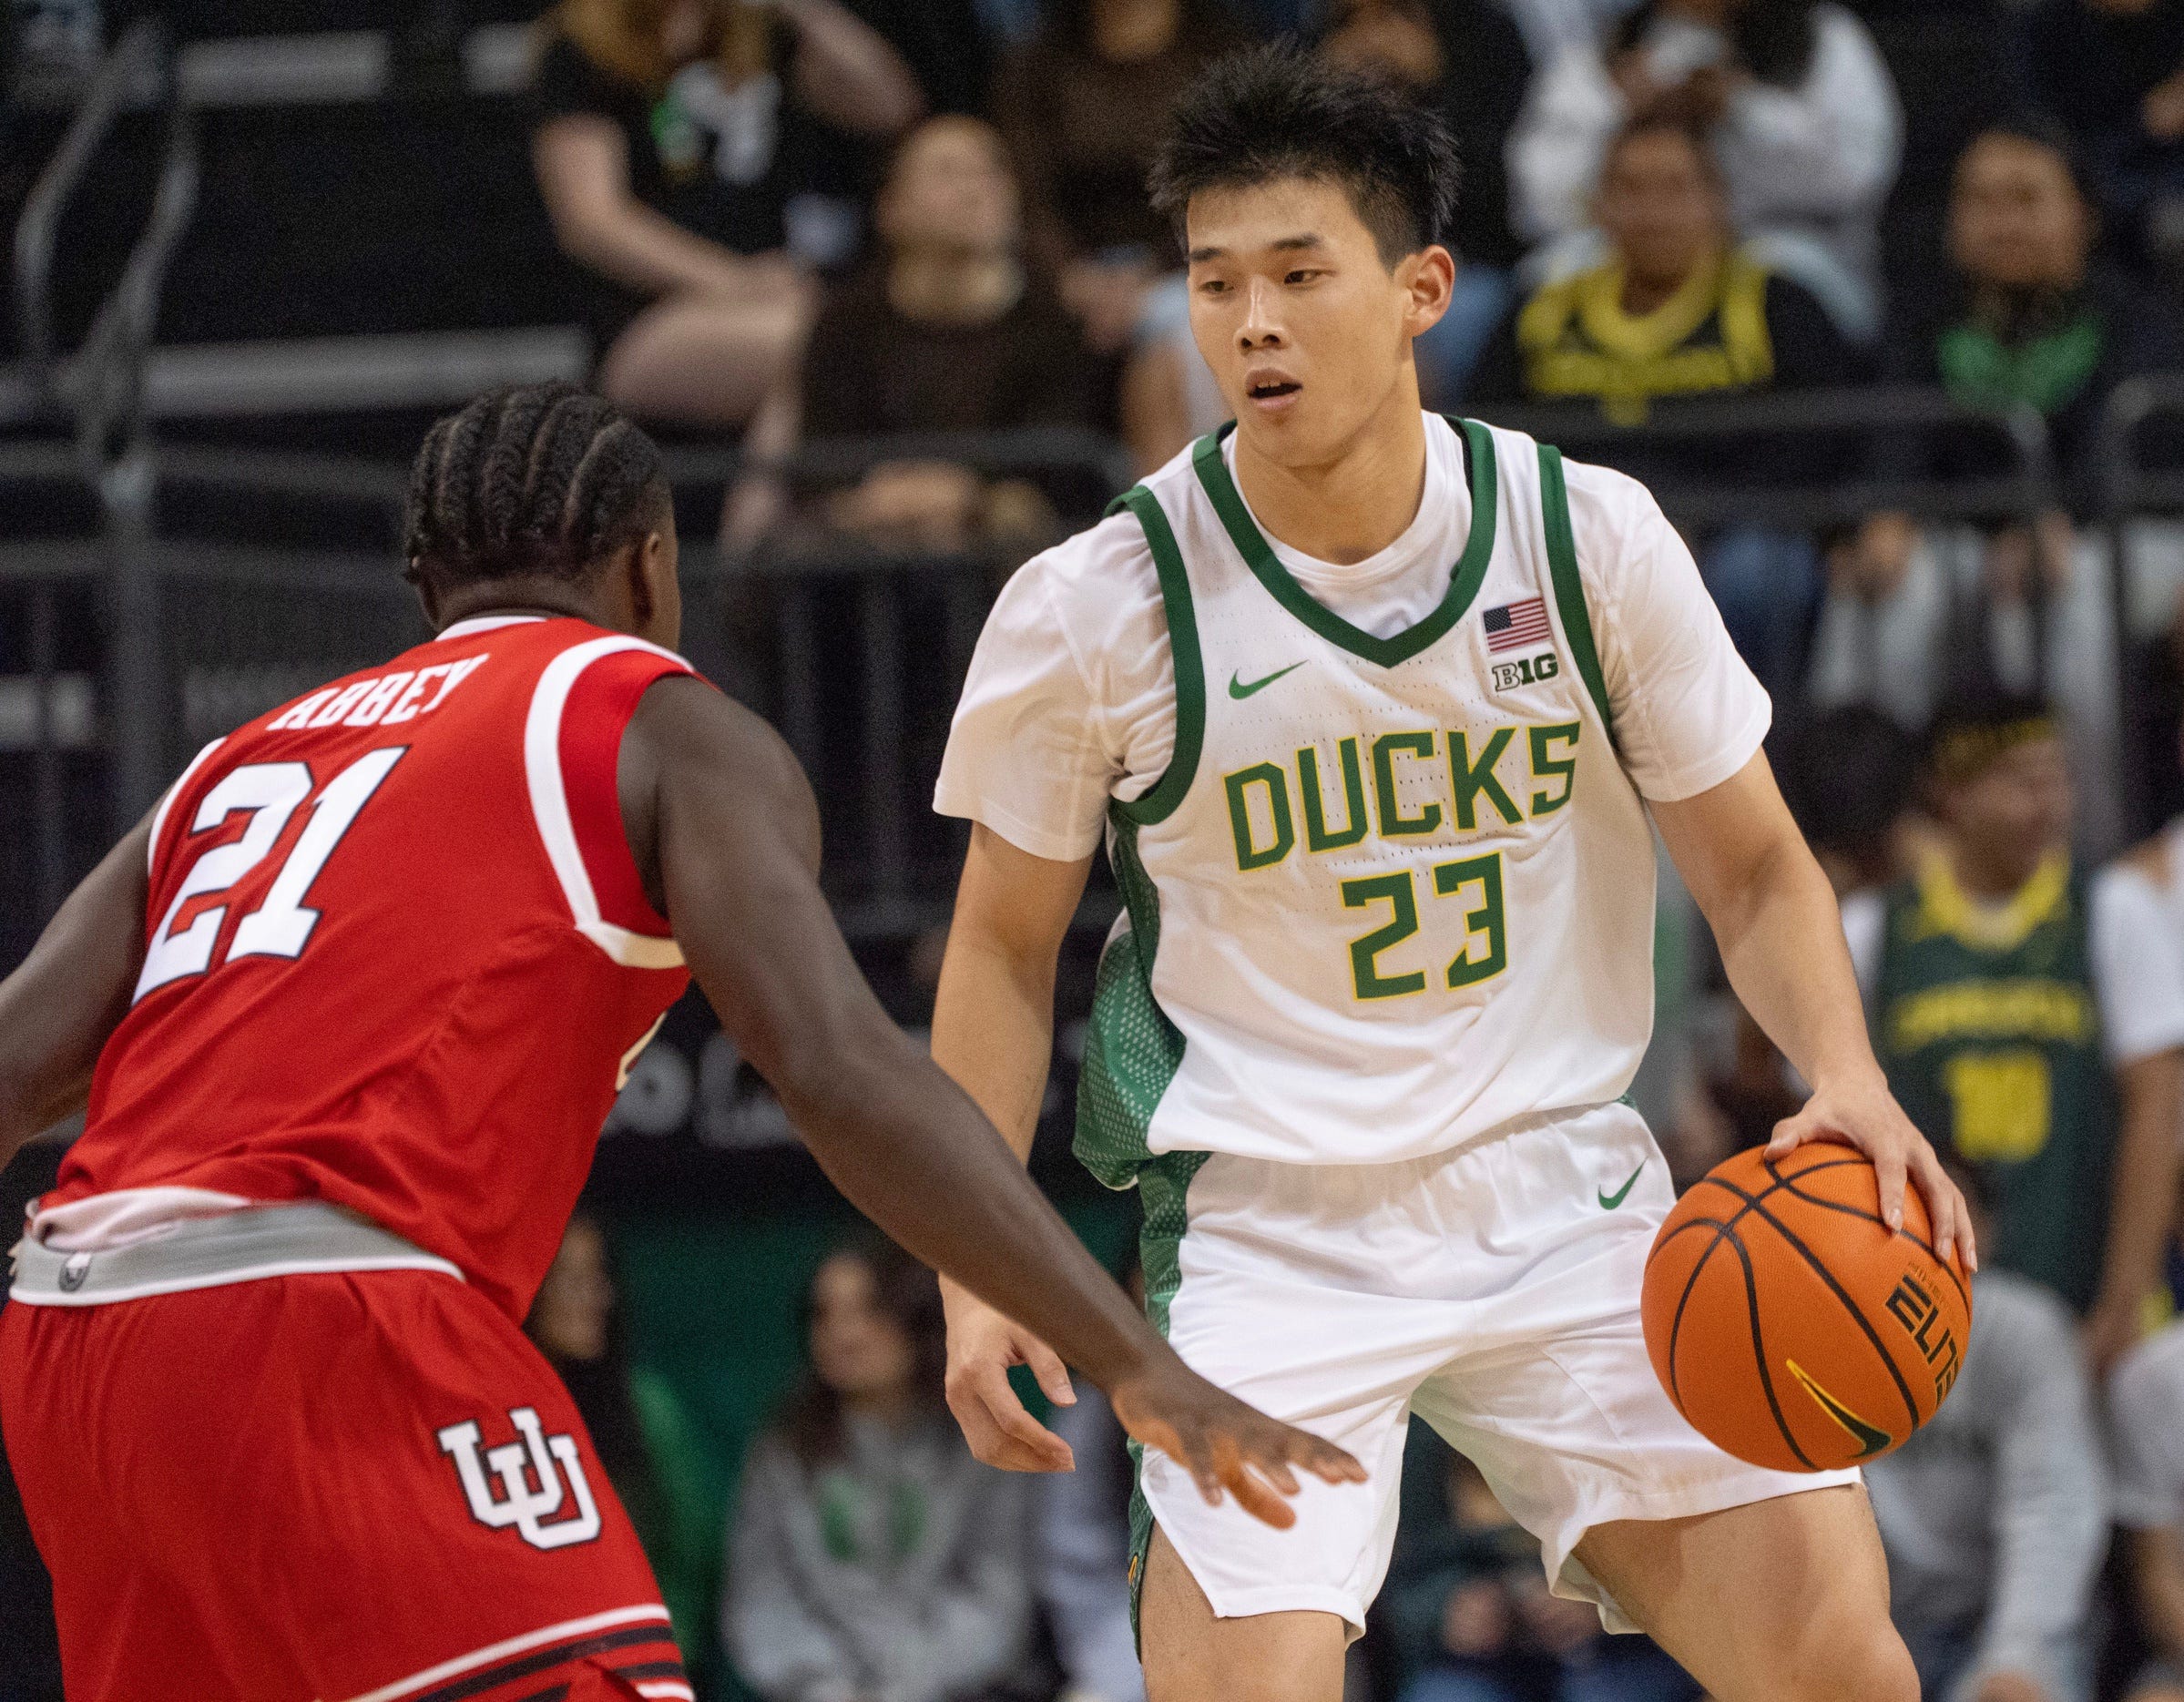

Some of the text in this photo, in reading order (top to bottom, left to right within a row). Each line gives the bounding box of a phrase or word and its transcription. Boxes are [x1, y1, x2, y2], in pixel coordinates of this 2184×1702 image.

[266, 652, 490, 731] ABBEY
[1223, 720, 1581, 871] DUCKS
[132, 743, 413, 1006] 21
[1340, 851, 1507, 1003] 23
